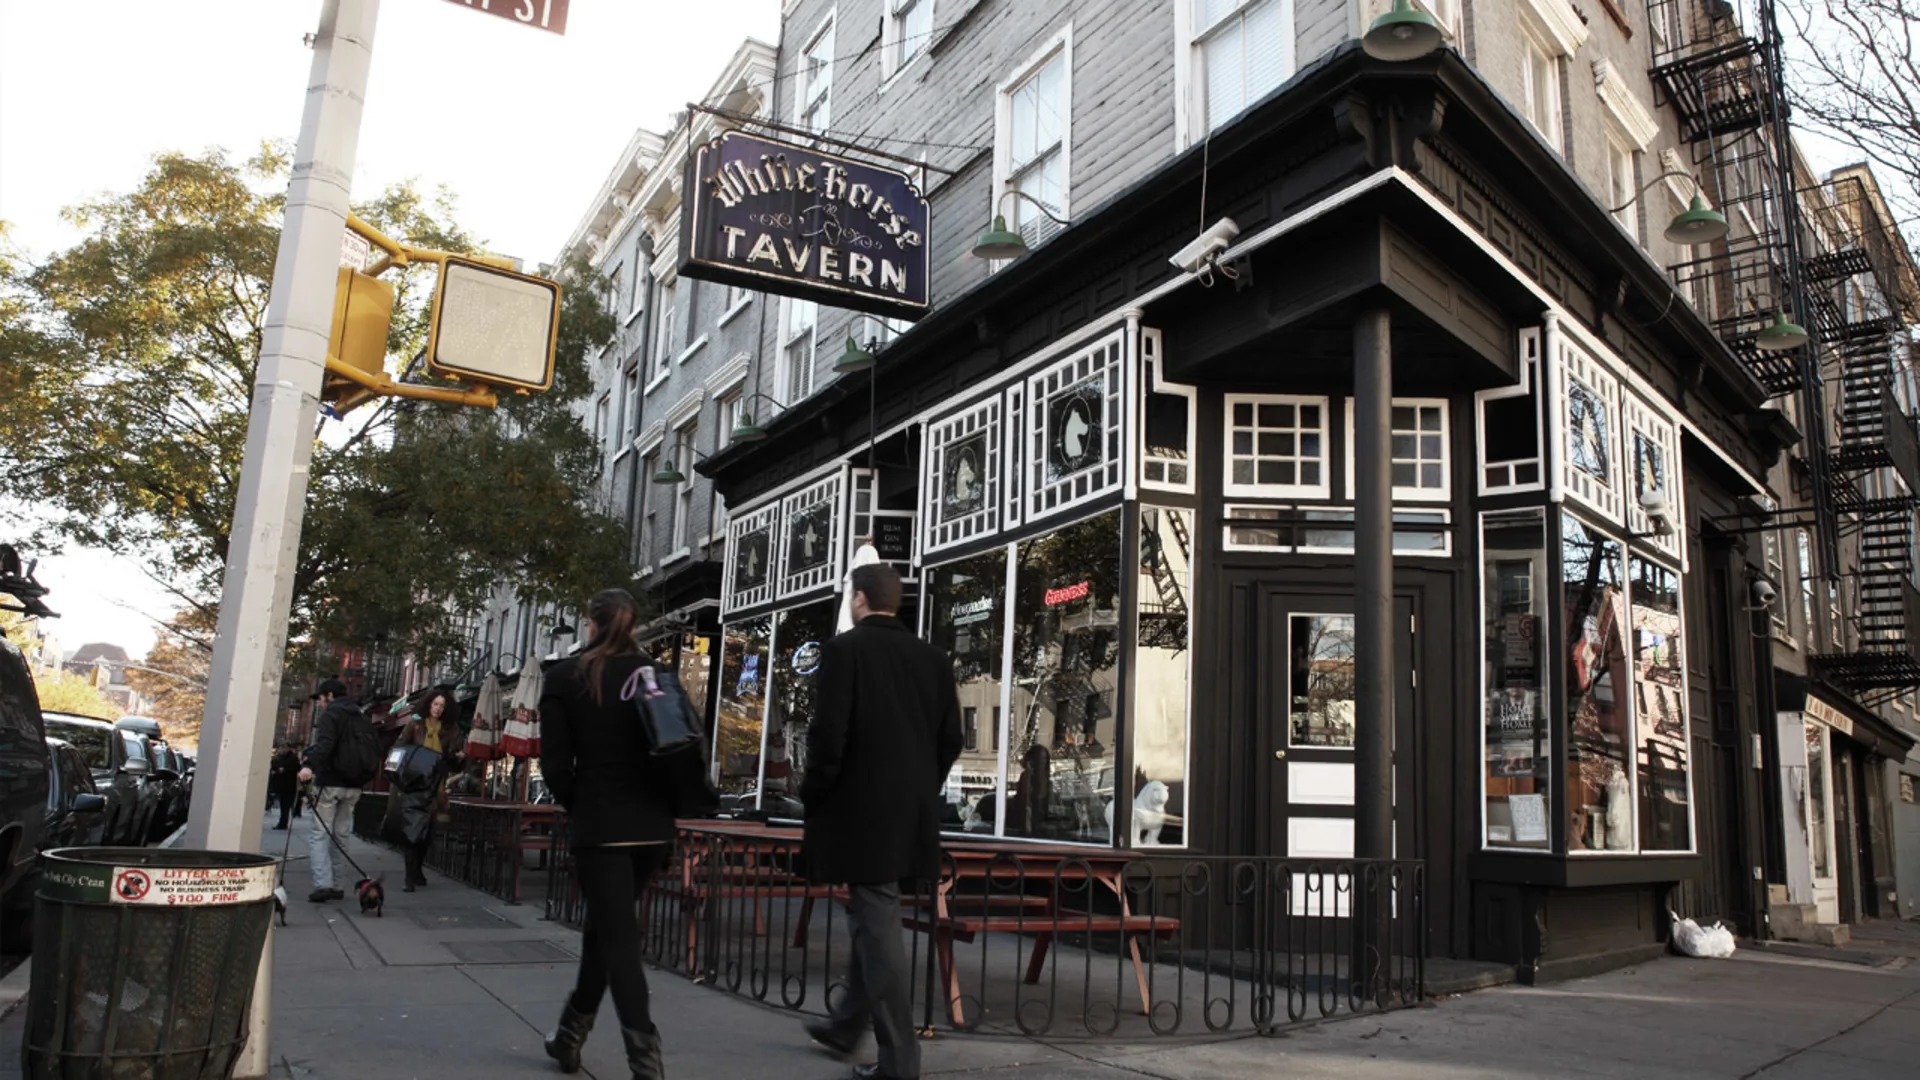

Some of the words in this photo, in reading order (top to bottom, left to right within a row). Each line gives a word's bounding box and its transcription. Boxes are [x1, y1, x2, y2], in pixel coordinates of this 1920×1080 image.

[706, 152, 817, 208] White
[820, 161, 922, 250] Horse
[722, 225, 908, 294] TAVERN
[884, 534, 900, 542] GIN
[1500, 720, 1532, 729] HOME
[164, 869, 210, 879] LITTER
[216, 869, 247, 878] ONLY
[167, 894, 204, 904] $100
[212, 892, 239, 903] FINE
